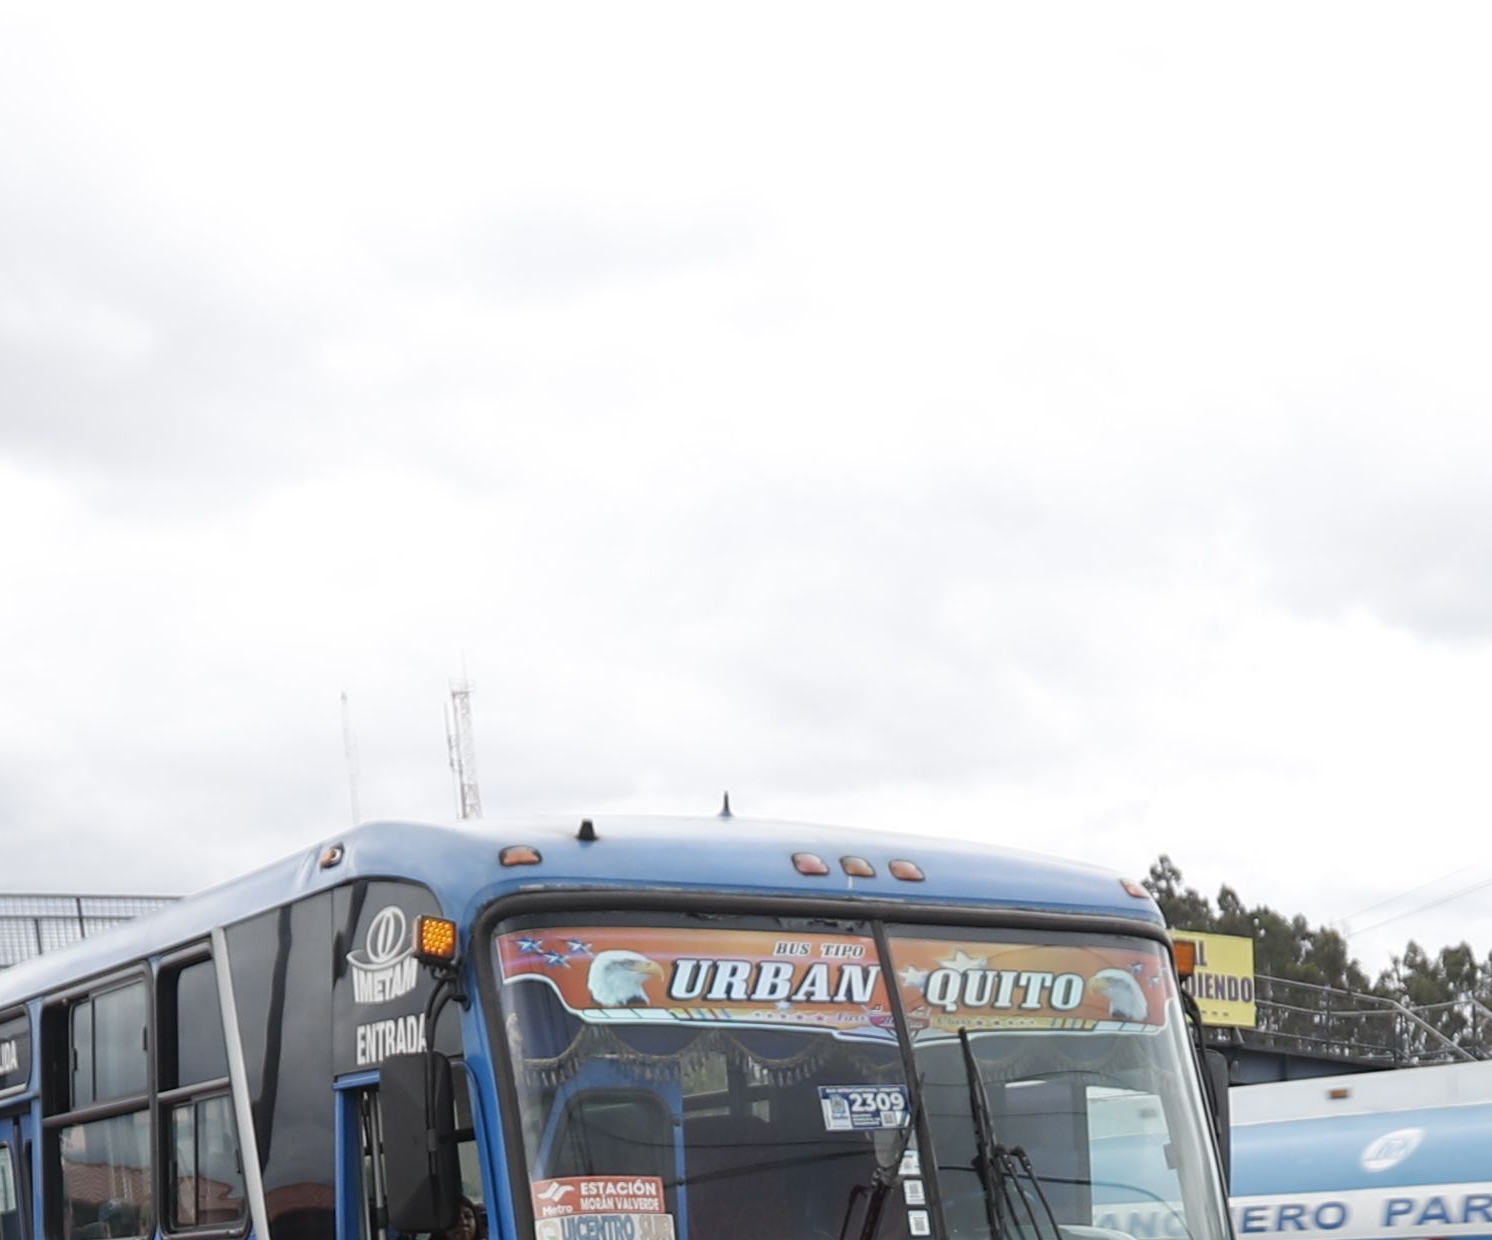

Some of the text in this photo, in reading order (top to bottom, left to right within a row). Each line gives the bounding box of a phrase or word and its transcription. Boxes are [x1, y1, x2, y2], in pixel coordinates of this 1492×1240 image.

[774, 941, 865, 958] BUS TIPO
[352, 955, 418, 1003] IMETAM
[669, 958, 881, 1003] URBAN
[926, 969, 1084, 1011] QUITO
[356, 1012, 428, 1065] ENTRADA
[849, 1092, 905, 1112] 2309
[580, 1179, 656, 1195] ESTACIÓN
[542, 1205, 573, 1217] Metro
[580, 1195, 659, 1210] MORÁN VALVERDE
